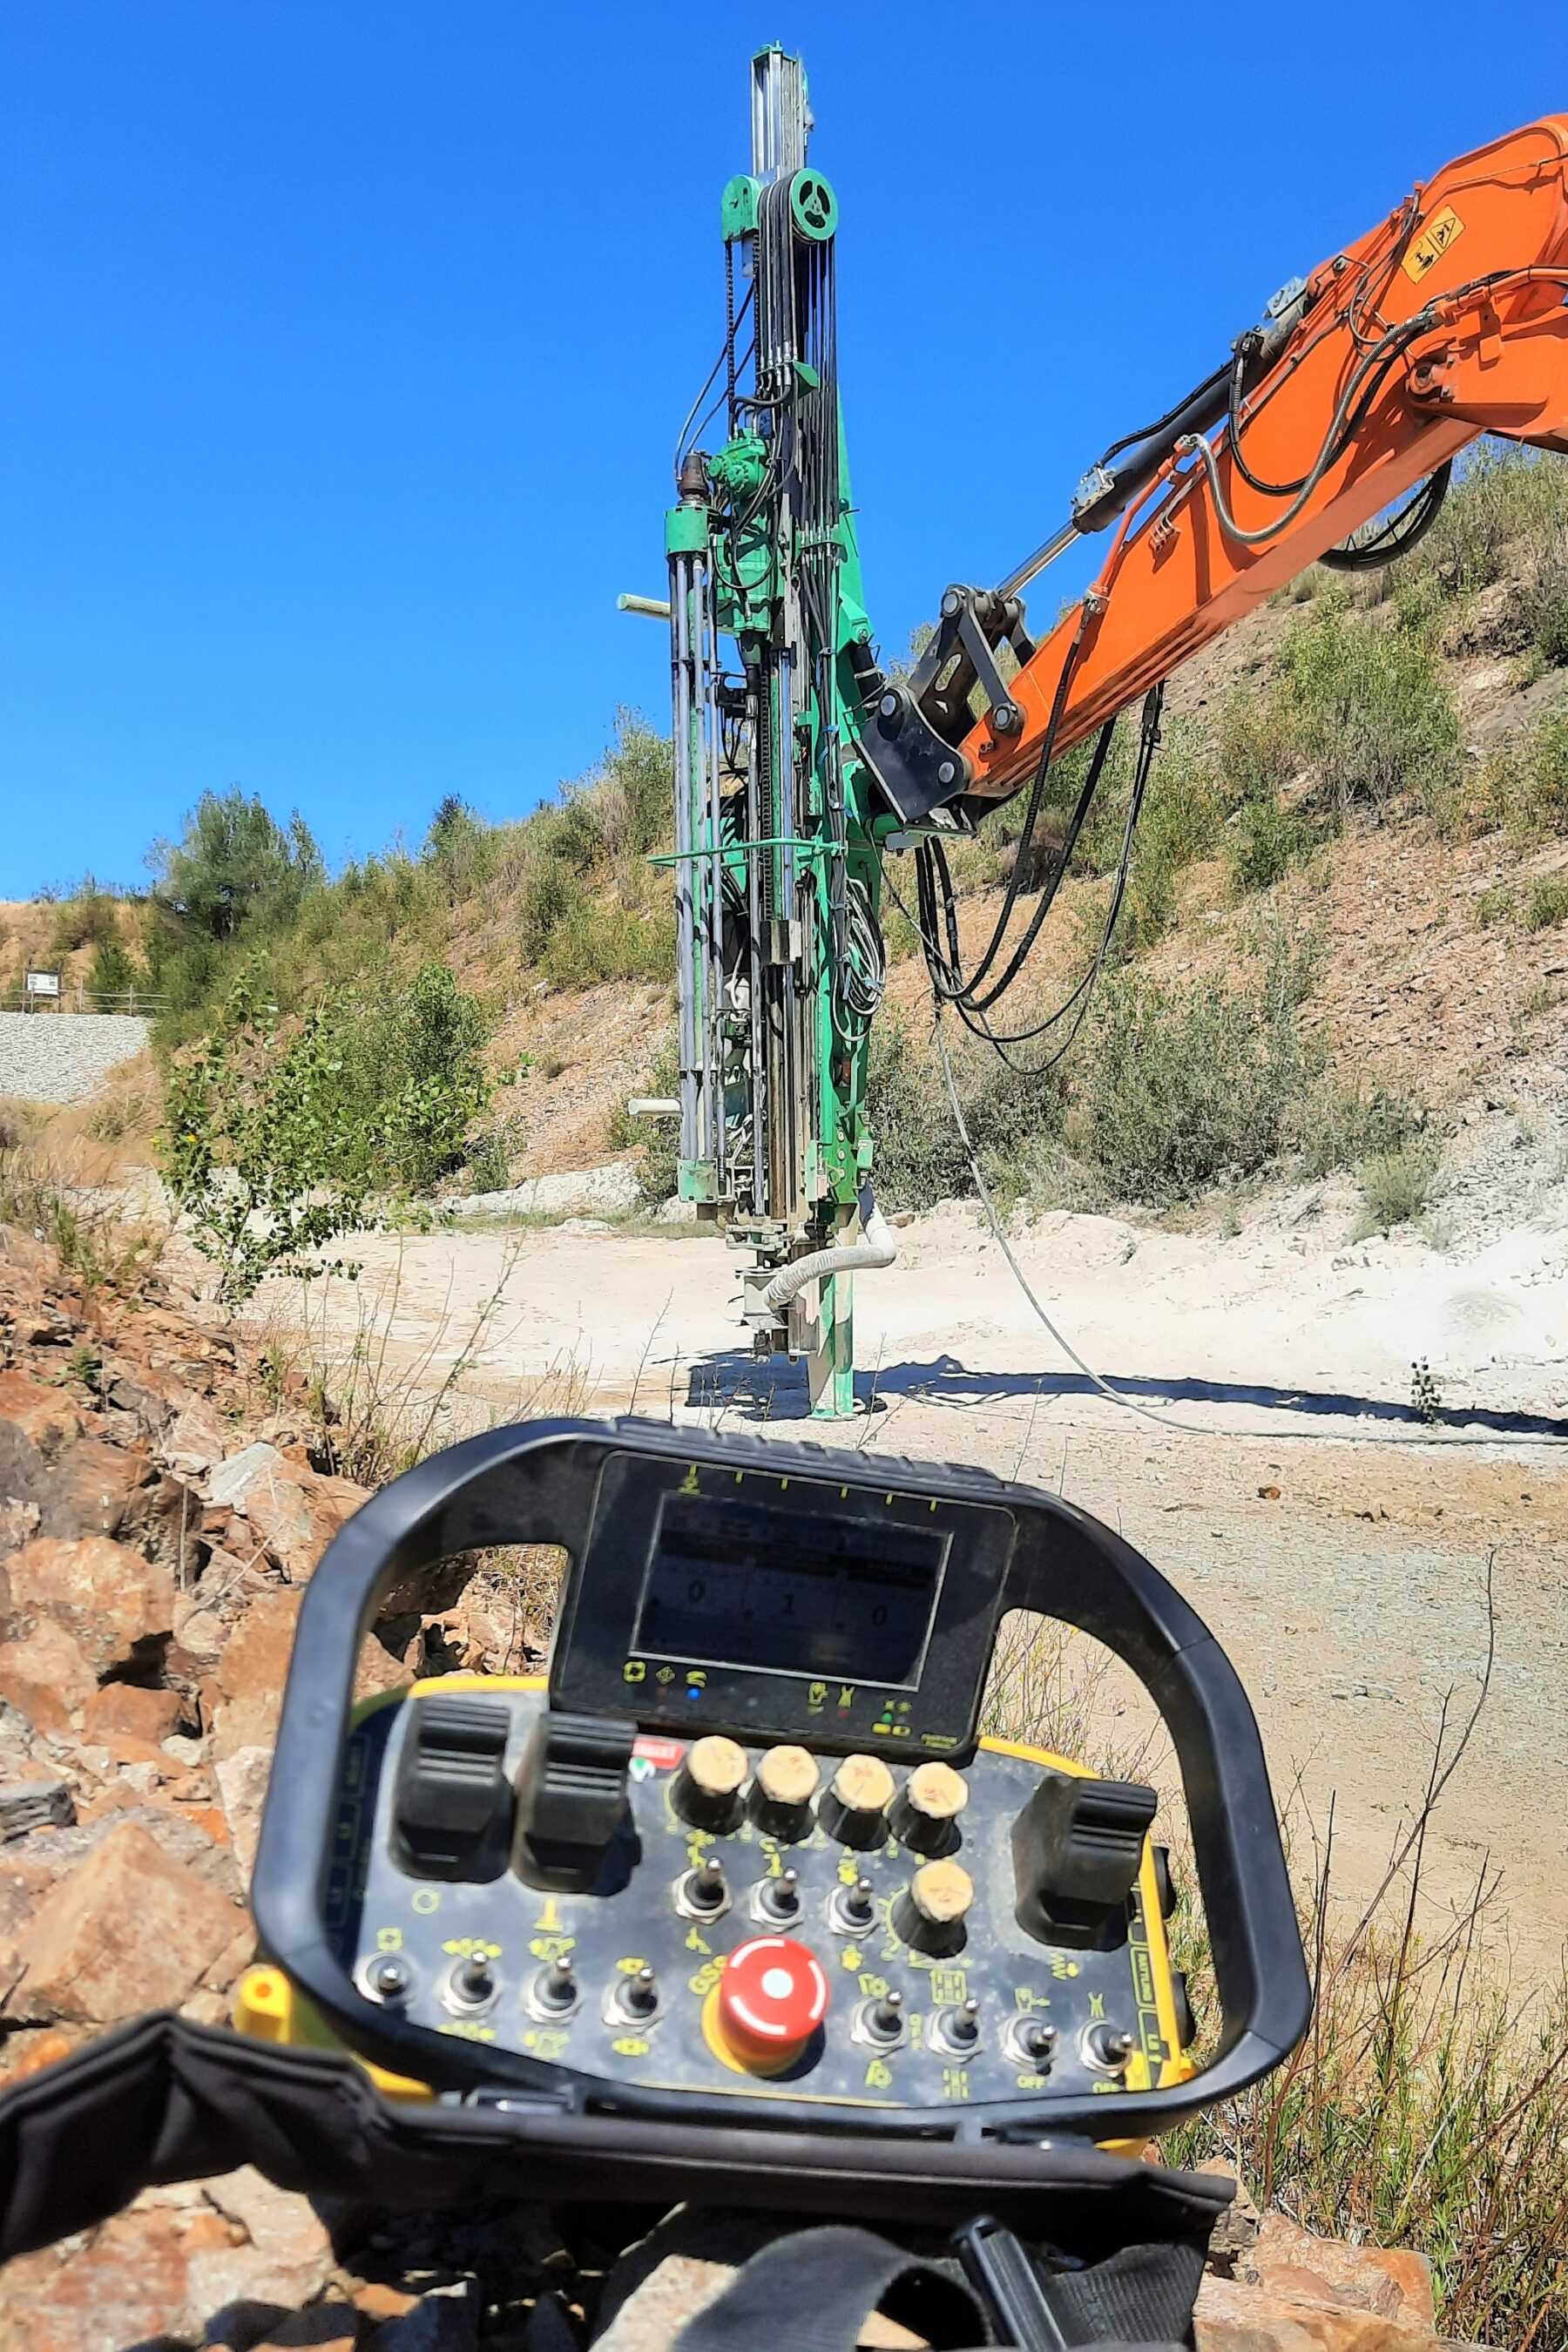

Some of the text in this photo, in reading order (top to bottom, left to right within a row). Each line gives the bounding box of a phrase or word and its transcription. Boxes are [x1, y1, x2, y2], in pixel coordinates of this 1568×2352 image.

[687, 1579, 706, 1604] 0
[781, 1593, 796, 1615] 1
[871, 1605, 887, 1625] 0
[1017, 2073, 1045, 2090] OFF
[1092, 2080, 1122, 2093] OFF
